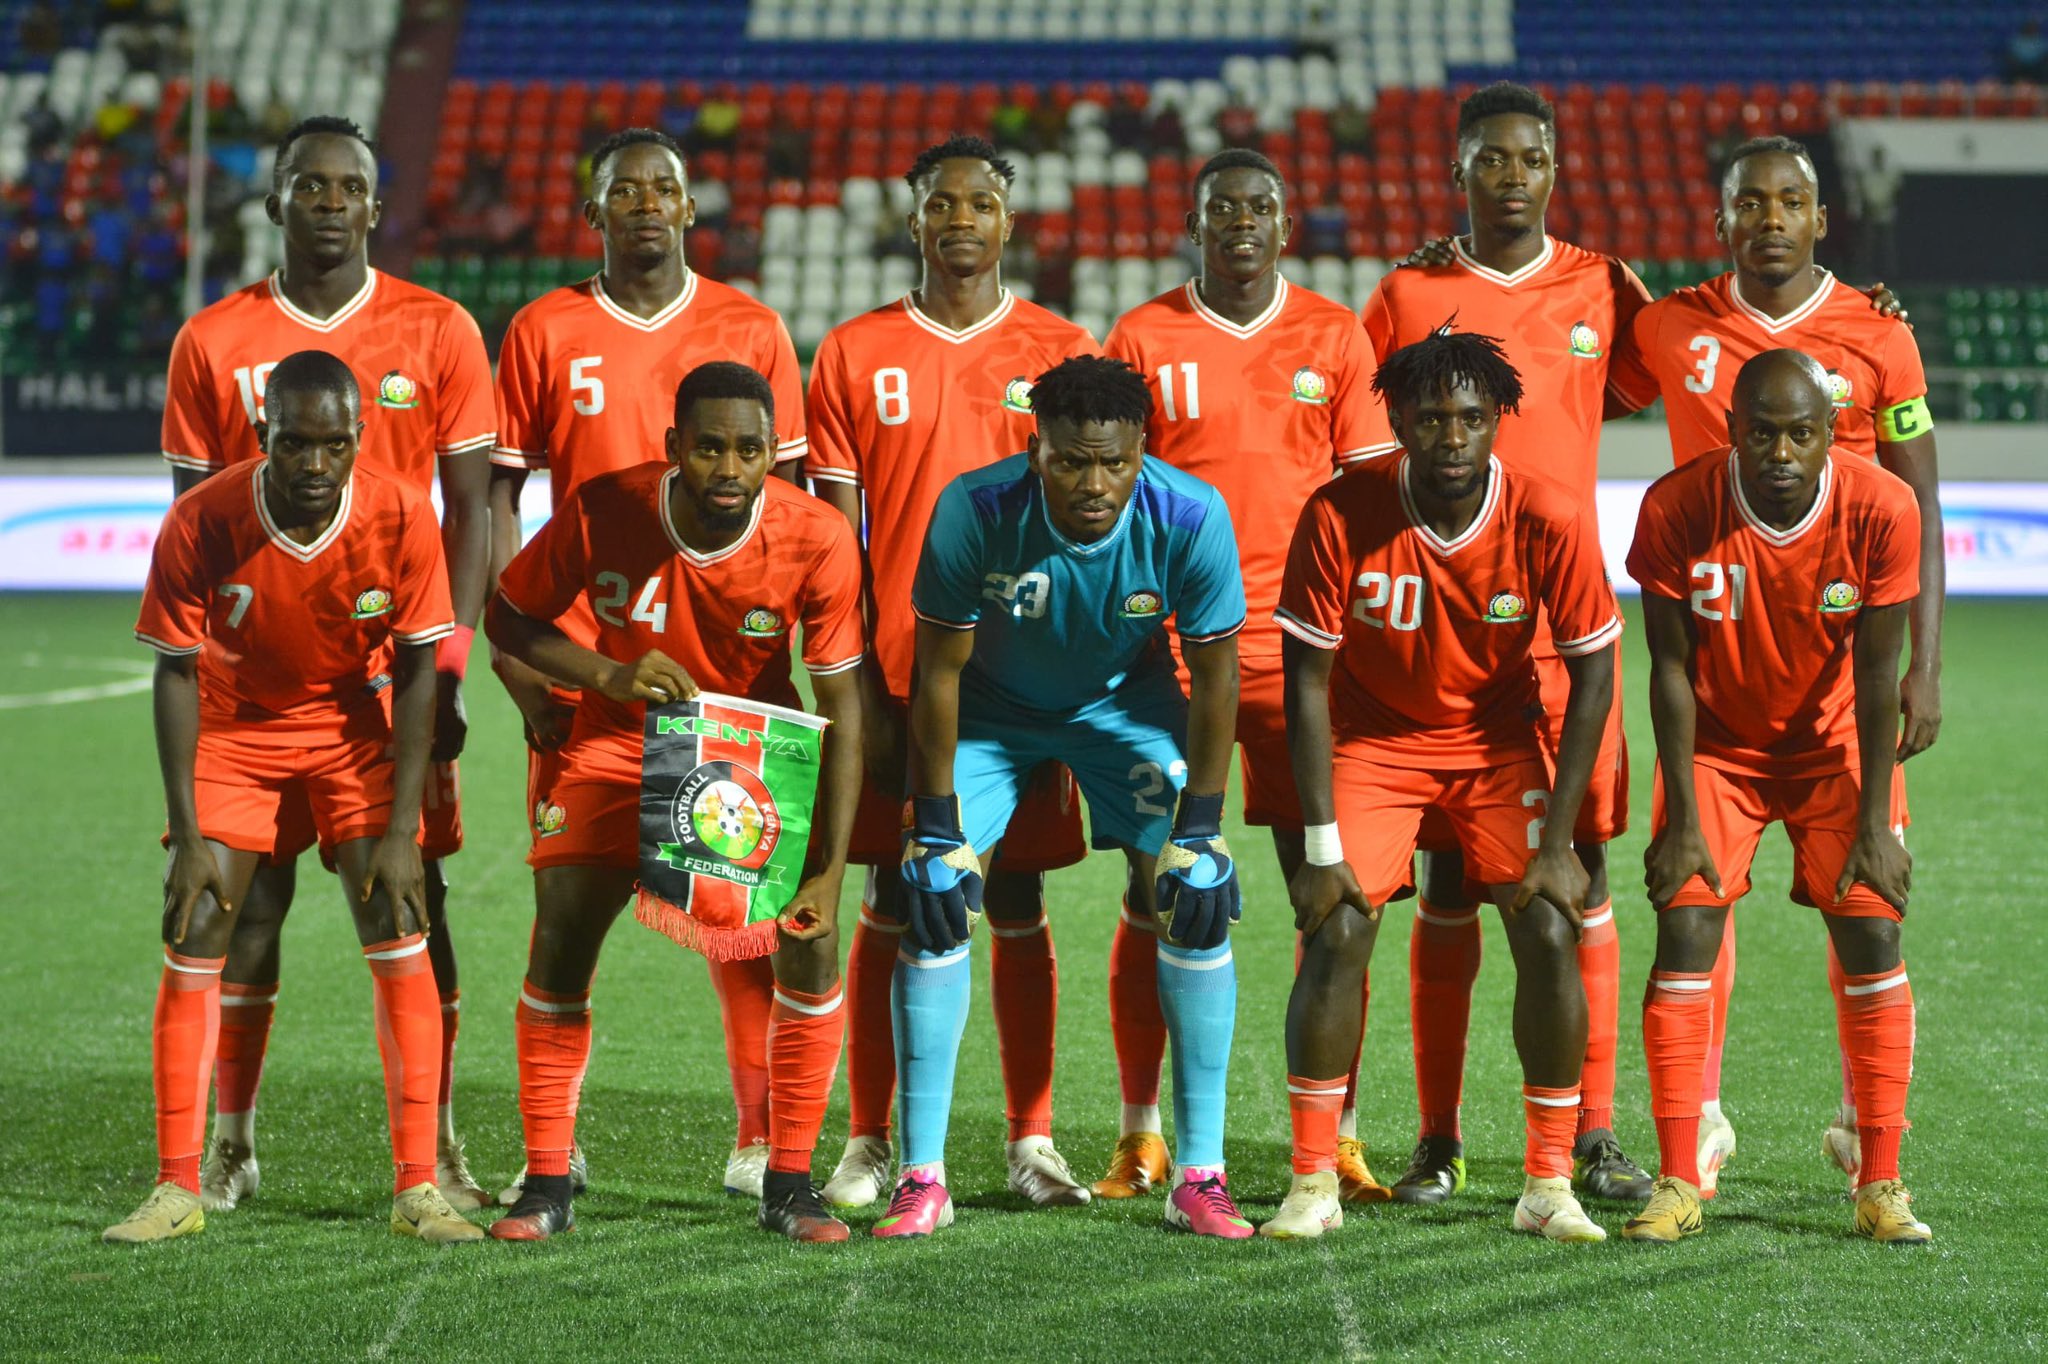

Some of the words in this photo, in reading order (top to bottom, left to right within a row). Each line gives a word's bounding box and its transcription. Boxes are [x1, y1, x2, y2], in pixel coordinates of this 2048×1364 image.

[570, 355, 604, 415] 5
[1157, 362, 1200, 421] 11
[1685, 335, 1721, 393] 3
[873, 367, 910, 425] 8
[1893, 404, 1918, 435] C
[219, 583, 254, 629] 7
[595, 571, 667, 633] 24
[982, 572, 1050, 619] 23
[1352, 571, 1426, 631] 20
[1691, 561, 1746, 621] 21
[656, 715, 809, 760] KENYA
[677, 772, 709, 844] FOOTBALL
[1127, 759, 1188, 817] 2
[759, 802, 777, 851] KENYA
[684, 856, 759, 884] FEDERATION
